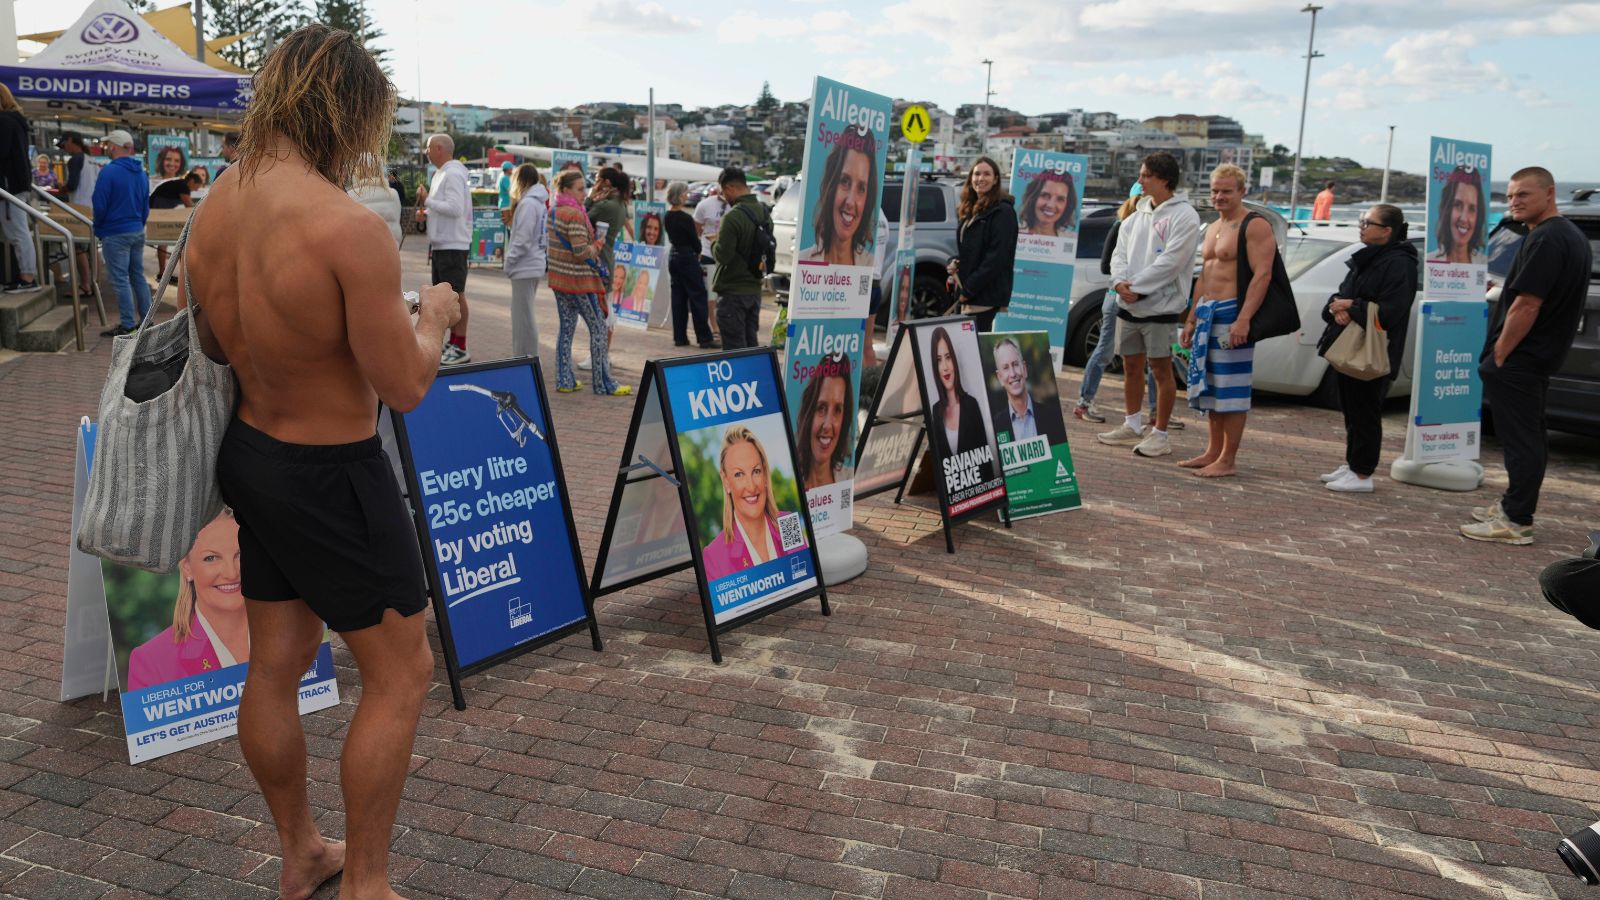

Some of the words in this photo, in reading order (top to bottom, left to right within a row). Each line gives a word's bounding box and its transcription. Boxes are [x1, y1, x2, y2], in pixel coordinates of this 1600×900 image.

[127, 49, 158, 59] City
[18, 76, 90, 93] BONDI
[98, 80, 190, 98] NIPPERS
[820, 87, 885, 136] Allegra
[152, 138, 186, 148] Allegra
[1020, 153, 1082, 174] Allegra
[1434, 142, 1487, 173] Allegra
[1029, 238, 1056, 247] values.
[636, 255, 657, 266] KNOX
[802, 270, 822, 284] Your
[824, 272, 852, 285] values.
[1429, 267, 1445, 277] Your
[1447, 268, 1471, 278] values.
[1429, 278, 1445, 288] Your
[800, 287, 819, 301] Your
[822, 288, 847, 302] voice.
[794, 325, 859, 362] Allegra
[1436, 350, 1472, 363] Reform
[707, 360, 732, 382] RO
[793, 360, 840, 384] Spender
[1435, 369, 1452, 380] our
[1455, 367, 1470, 379] tax
[688, 381, 763, 420] KNOX
[1434, 384, 1470, 399] system
[1422, 433, 1438, 441] Your
[943, 445, 994, 476] SAVANNA
[1017, 440, 1045, 462] WARD
[420, 465, 483, 496] Every
[487, 456, 528, 481] litre
[946, 466, 981, 494] PEAKE
[949, 491, 965, 504] LABOR
[965, 489, 975, 498] FOR
[975, 477, 1003, 494] WENTWORTH
[428, 500, 472, 529] 25c
[476, 480, 556, 517] cheaper
[435, 538, 463, 565] by
[468, 520, 533, 553] voting
[443, 552, 517, 597] Liberal
[715, 580, 737, 592] LIBERAL
[737, 575, 748, 585] FOR
[792, 570, 808, 580] LIBERAL
[717, 572, 785, 606] WENTWORTH
[510, 614, 533, 629] LIBERAL
[141, 686, 183, 704] LIBERAL
[184, 681, 205, 692] FOR
[298, 684, 331, 700] TRACK
[136, 730, 167, 746] LET'S
[170, 723, 191, 736] GET
